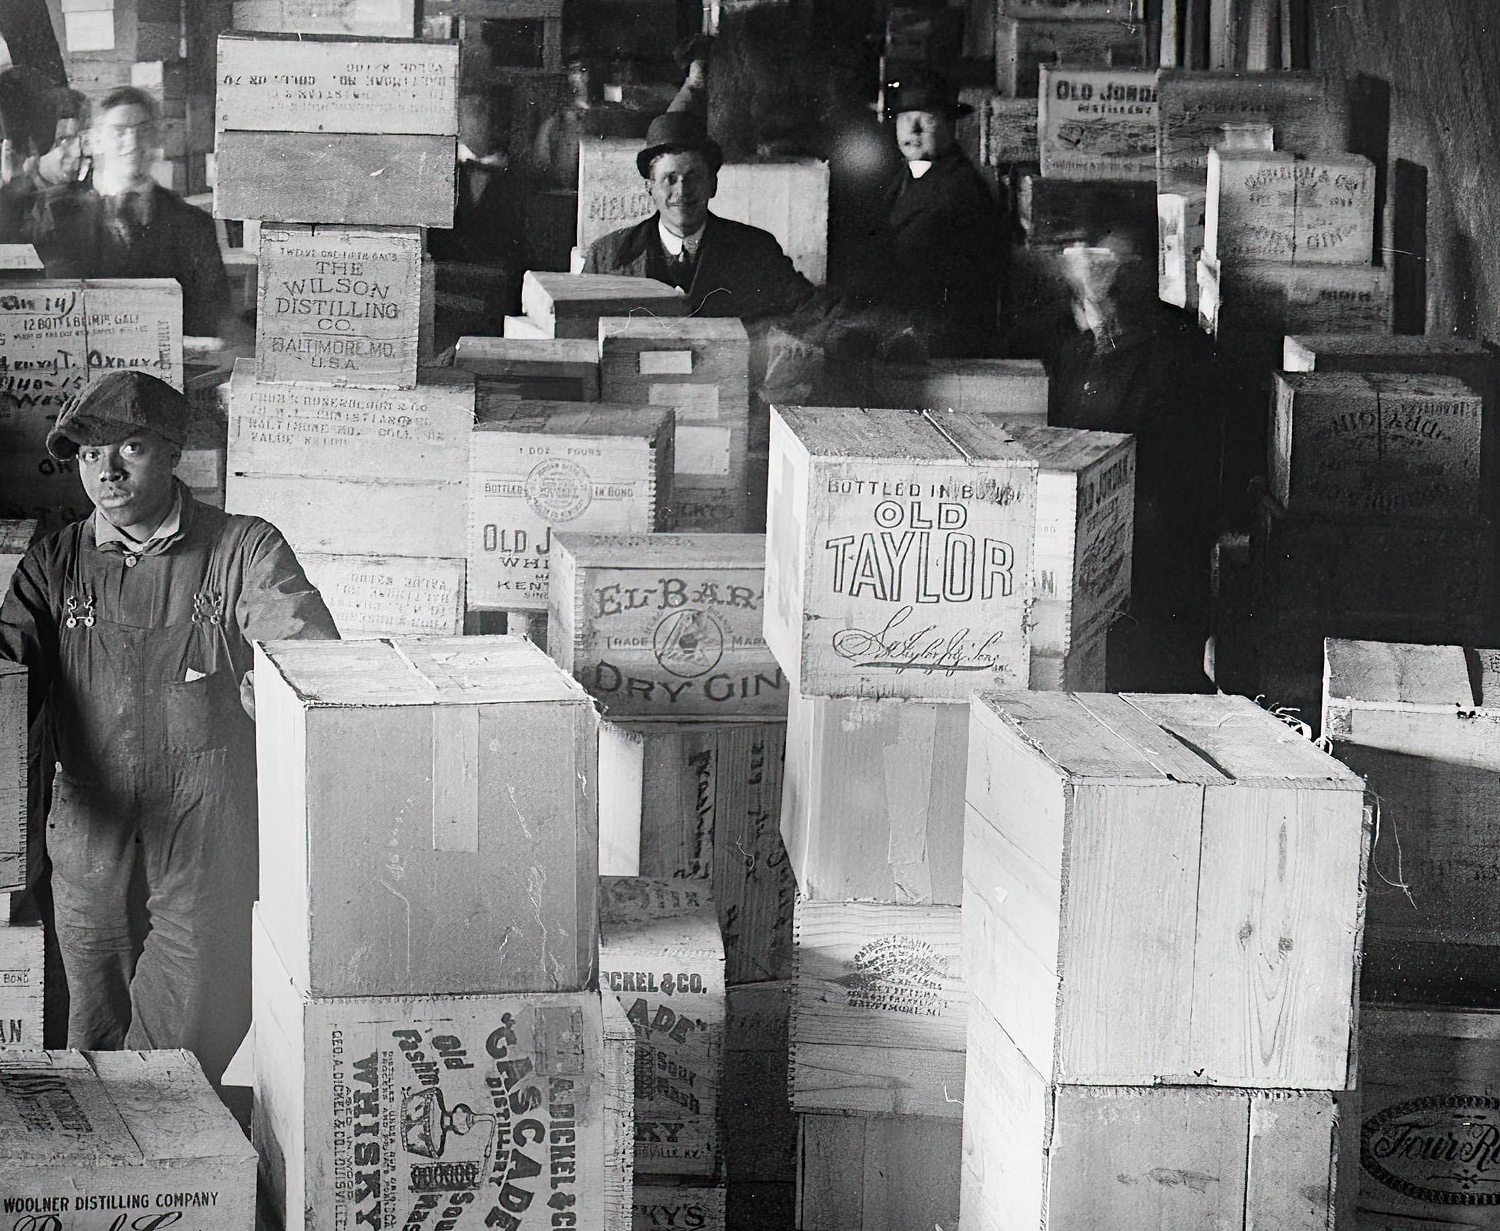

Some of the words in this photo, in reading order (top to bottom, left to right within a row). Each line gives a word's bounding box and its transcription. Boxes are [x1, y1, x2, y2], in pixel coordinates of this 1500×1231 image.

[315, 261, 364, 277] THE
[282, 277, 390, 300] WILSON
[275, 297, 399, 319] DISTILLING
[317, 318, 356, 332] CO.
[484, 483, 524, 495] BOTTLED
[607, 486, 634, 498] BOND
[827, 479, 921, 497] BOTTLED
[930, 483, 951, 498] IN
[874, 500, 968, 530] OLD
[483, 524, 528, 554] OLD
[499, 557, 550, 569] WHI
[825, 531, 1015, 604] TAYLOR
[594, 577, 765, 619] EL-BAR
[605, 635, 649, 650] TRADE
[594, 659, 693, 703] DRY
[702, 666, 784, 702] GIN
[2, 973, 30, 984] BOND
[608, 971, 659, 993] CKEL
[660, 972, 677, 997] &
[676, 972, 708, 995] CO.
[431, 1034, 475, 1070] Old
[332, 1072, 345, 1116] DICKEL
[345, 1086, 354, 1126] AGED
[332, 1117, 345, 1130] &
[484, 1076, 512, 1187] DISTILLERY
[352, 1050, 382, 1231] WHISKY
[549, 1103, 577, 1190] DICKEL
[1372, 1122, 1459, 1161] Four
[3, 1196, 70, 1214] WOOLNER
[75, 1193, 150, 1212] DISTILLING
[155, 1191, 219, 1208] COMPANY
[401, 1193, 444, 1231] Mas
[434, 1191, 476, 1231] Sou
[546, 1191, 577, 1211] &
[551, 1211, 578, 1231] C
